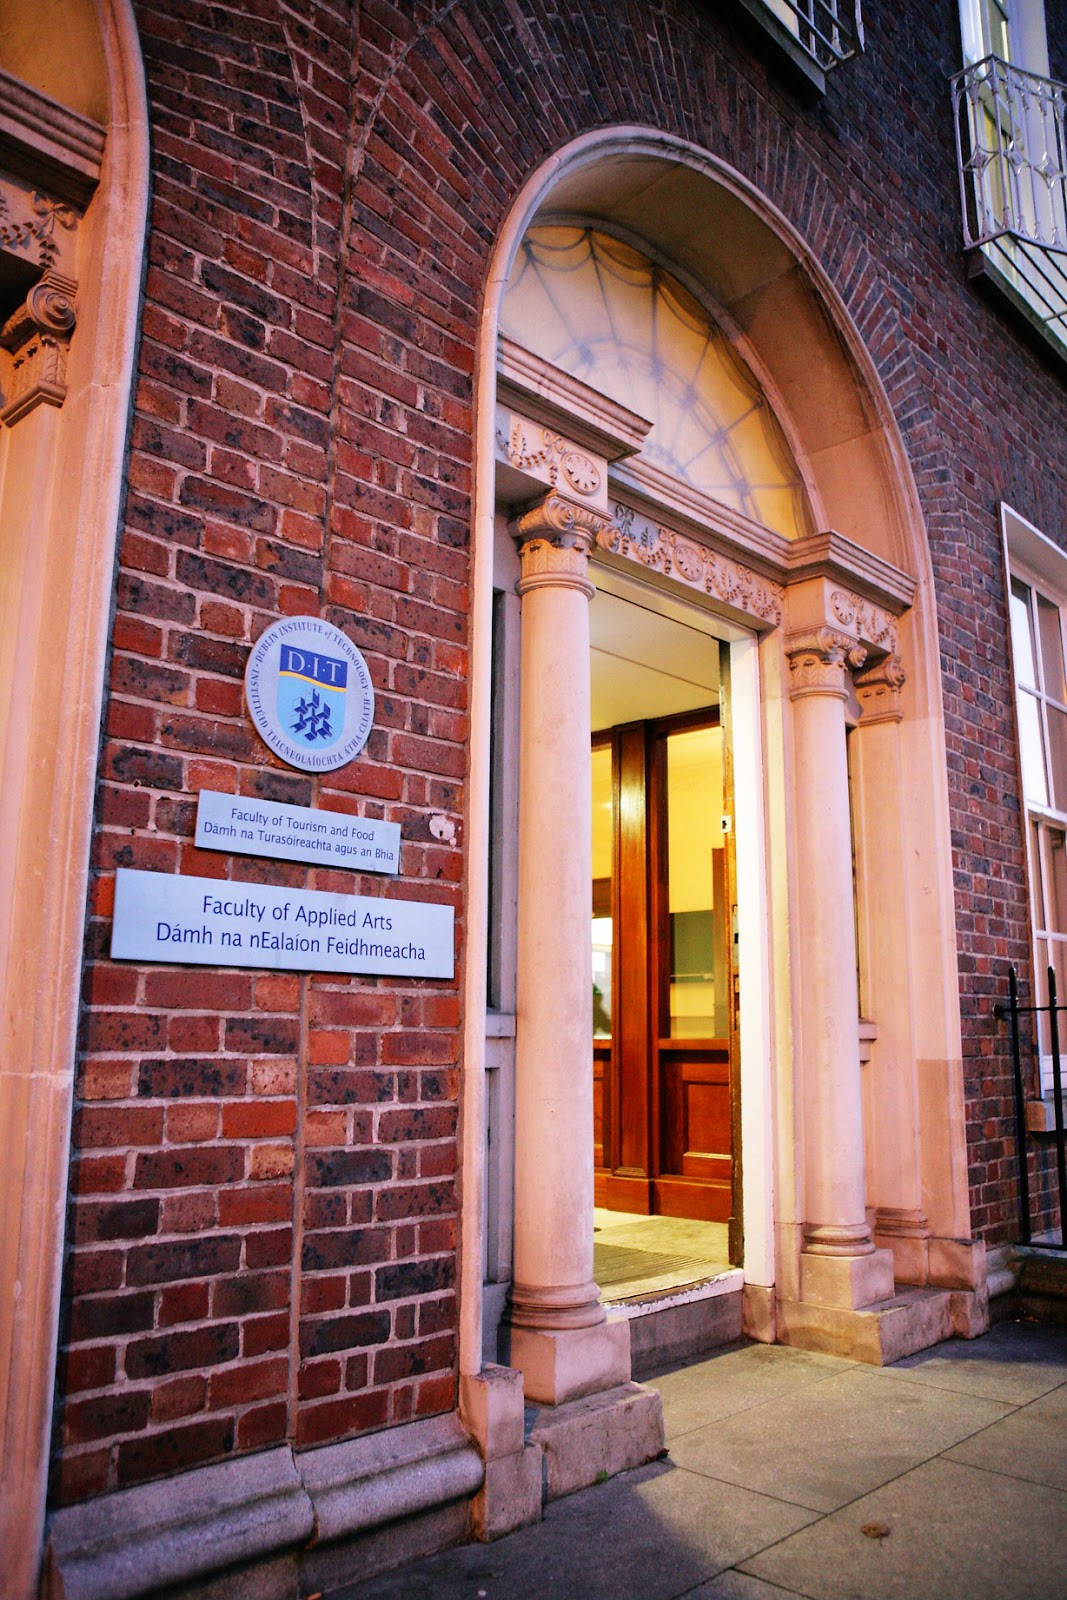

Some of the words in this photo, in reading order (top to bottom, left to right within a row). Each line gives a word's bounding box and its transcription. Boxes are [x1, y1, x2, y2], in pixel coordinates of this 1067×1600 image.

[256, 633, 279, 663] DUBLIN
[279, 621, 323, 636] INSTITUTE
[324, 631, 333, 640] of
[332, 634, 370, 690] TECHNOLOGY
[251, 669, 268, 728] INSTITIÚID
[267, 729, 343, 766] TEICNEOLAÍOCHTA
[344, 735, 362, 756] ÁTHA
[359, 698, 371, 733] CLIATH
[204, 822, 236, 837] Dámh
[241, 830, 254, 840] na
[258, 829, 332, 851] Turasóireachta
[335, 843, 357, 855] agus
[361, 848, 372, 857] an
[375, 848, 394, 861] Bhia
[231, 808, 269, 826] Faculty
[272, 815, 284, 826] of
[286, 817, 327, 834] Tourism
[330, 825, 348, 837] and
[352, 828, 374, 841] Food
[203, 895, 266, 922] Faculty
[272, 902, 291, 921] of
[295, 905, 356, 929] Applied
[362, 912, 393, 931] Arts
[157, 922, 213, 945] Dámh
[221, 932, 242, 947] na
[250, 931, 320, 953] nEalaíon
[327, 936, 426, 961] Feidhmeacha
